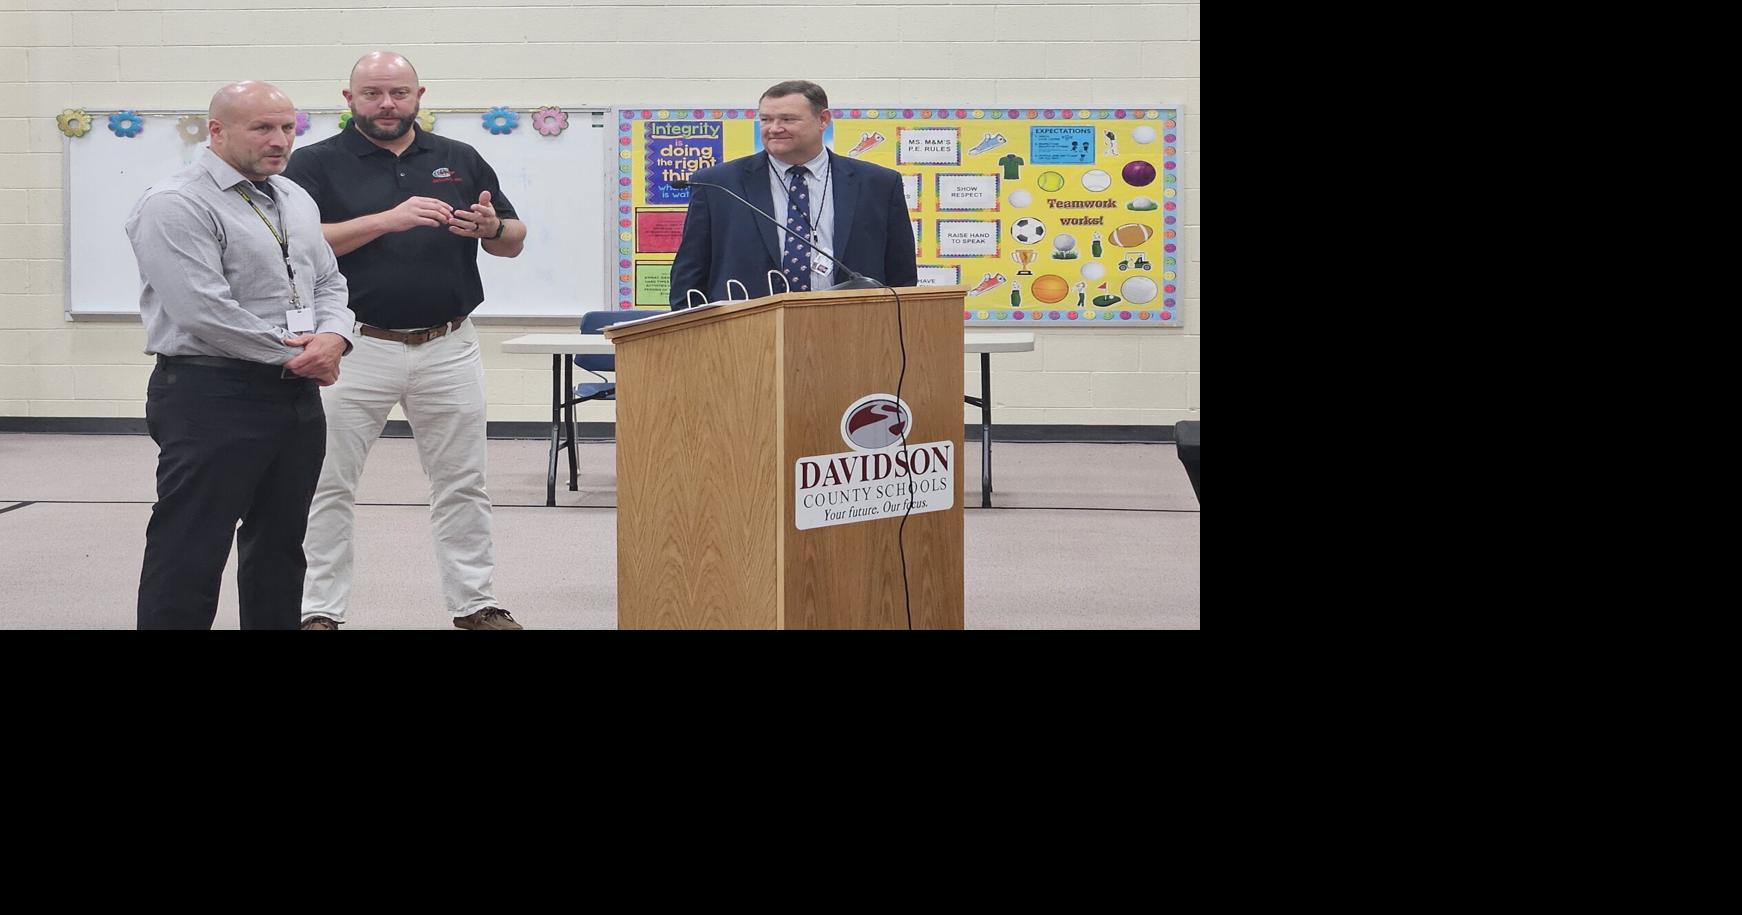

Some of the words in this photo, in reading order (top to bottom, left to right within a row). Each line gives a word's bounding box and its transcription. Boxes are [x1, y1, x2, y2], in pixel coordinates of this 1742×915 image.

[652, 122, 720, 138] Integrity
[675, 139, 684, 147] is
[660, 144, 713, 159] doing
[657, 158, 673, 167] the
[674, 157, 717, 172] right
[662, 169, 694, 182] thin
[1047, 198, 1117, 209] Teamwork
[1060, 215, 1104, 226] works!
[800, 445, 951, 490] DAVIDSON
[803, 486, 872, 509] COUNTY
[876, 477, 948, 499] SCHOOLS
[824, 508, 847, 521] Your
[848, 505, 880, 518] future.
[883, 500, 901, 513] Our
[902, 498, 929, 512] focus.
